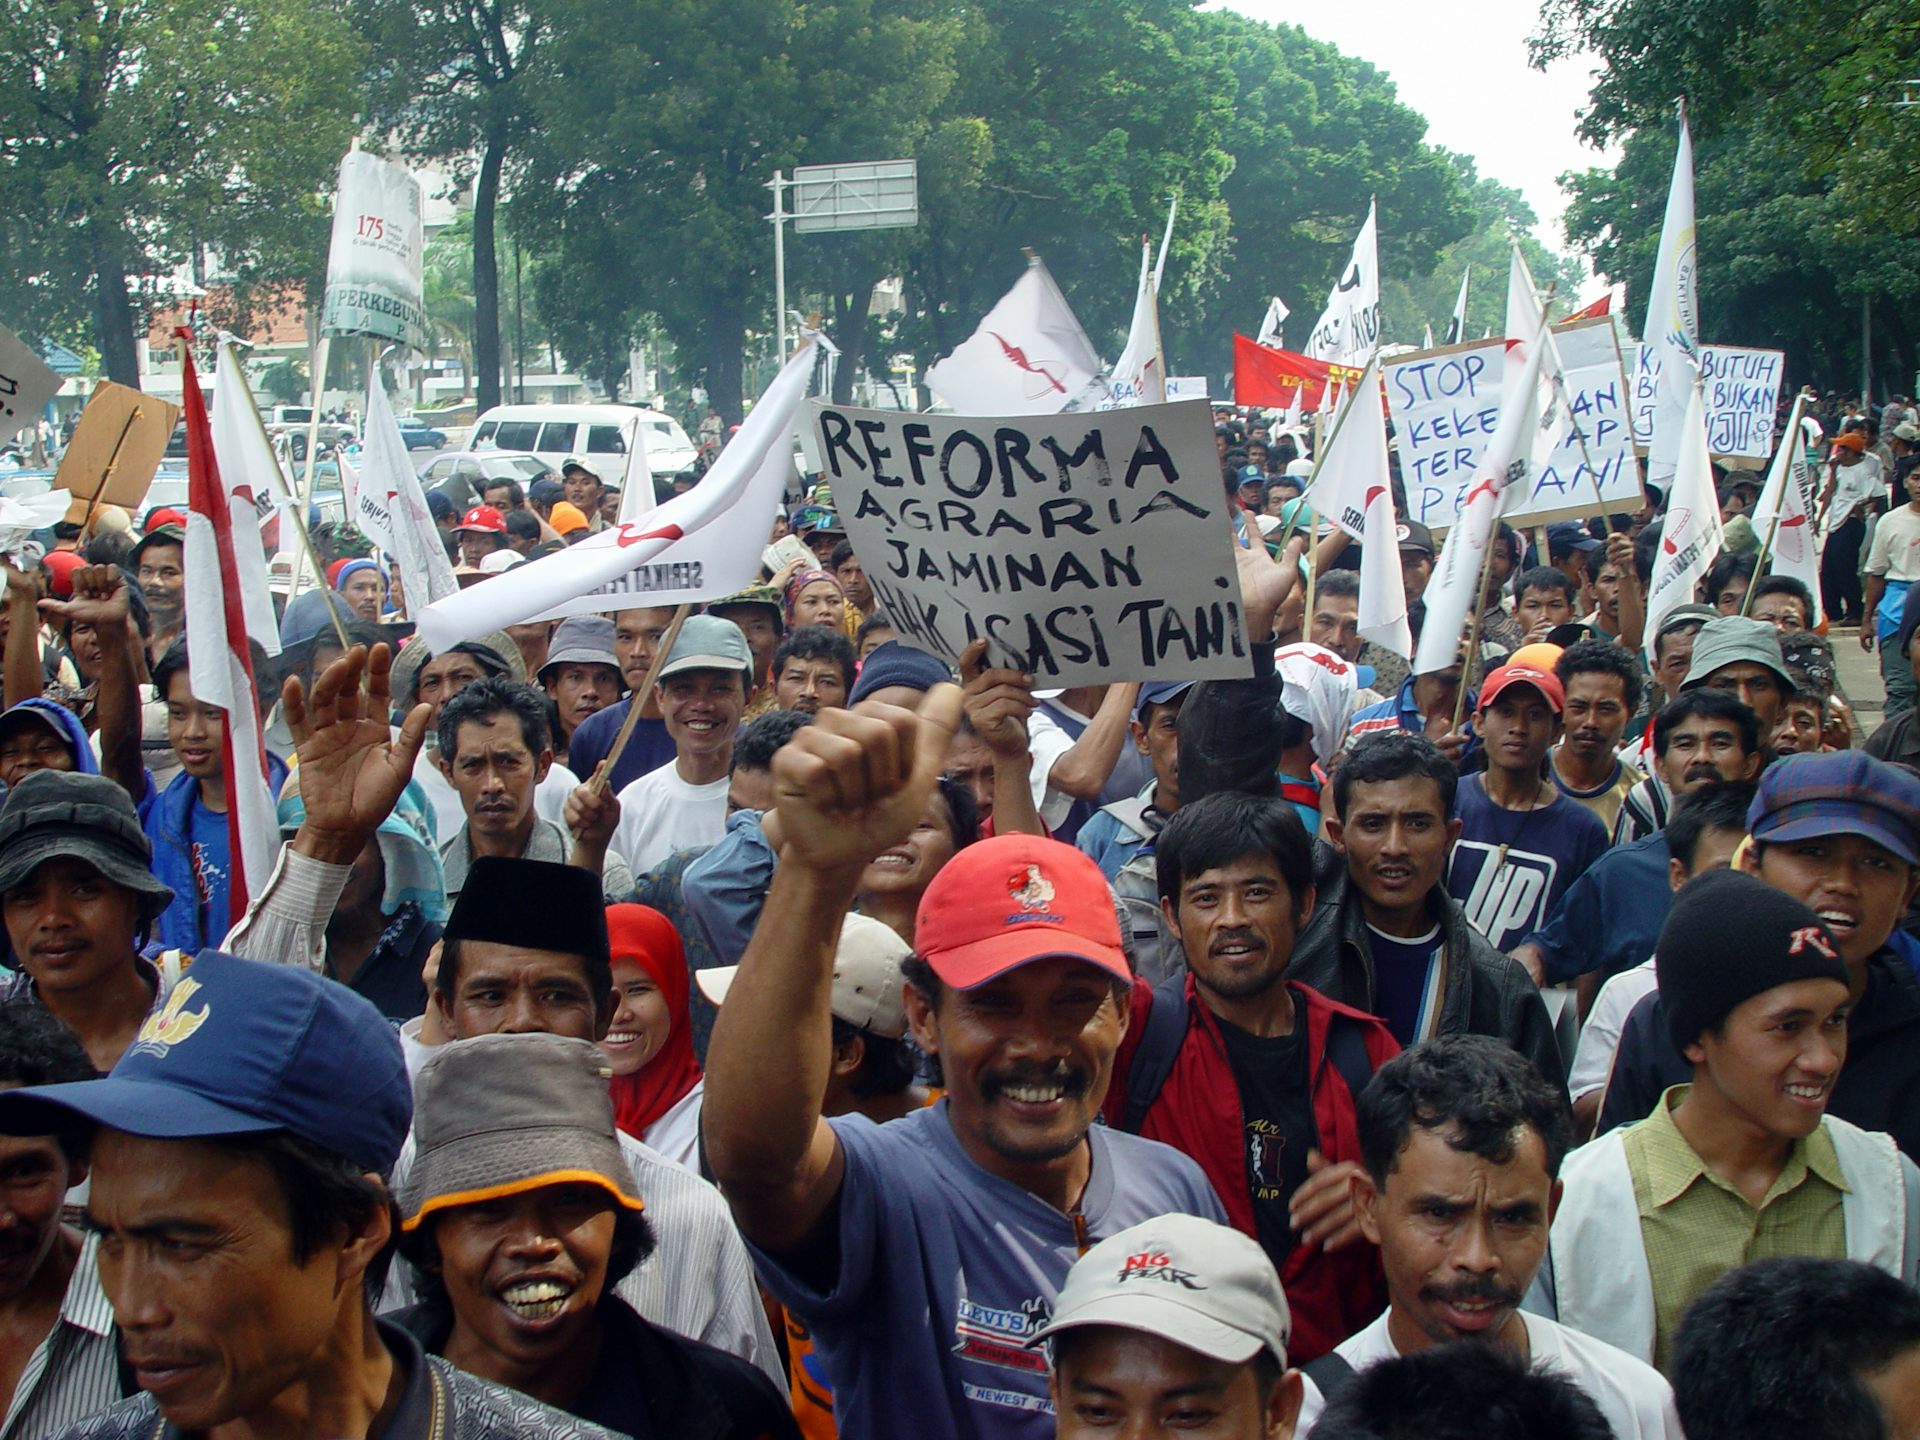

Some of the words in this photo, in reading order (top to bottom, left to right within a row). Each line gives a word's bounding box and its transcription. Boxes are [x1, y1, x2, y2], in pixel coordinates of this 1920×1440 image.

[357, 214, 384, 239] 175
[1395, 355, 1485, 410] STOP
[1700, 351, 1777, 384] BUTUH
[1713, 385, 1777, 415] BUKAN
[820, 410, 1180, 499] REFORMA
[855, 489, 1211, 538] AGRARIA
[886, 535, 1142, 594] JAMINAN
[868, 574, 960, 660] HAK
[1126, 1252, 1170, 1271] NO
[960, 1302, 1024, 1331] LEVI'S
[976, 1389, 1029, 1407] NEWEST
